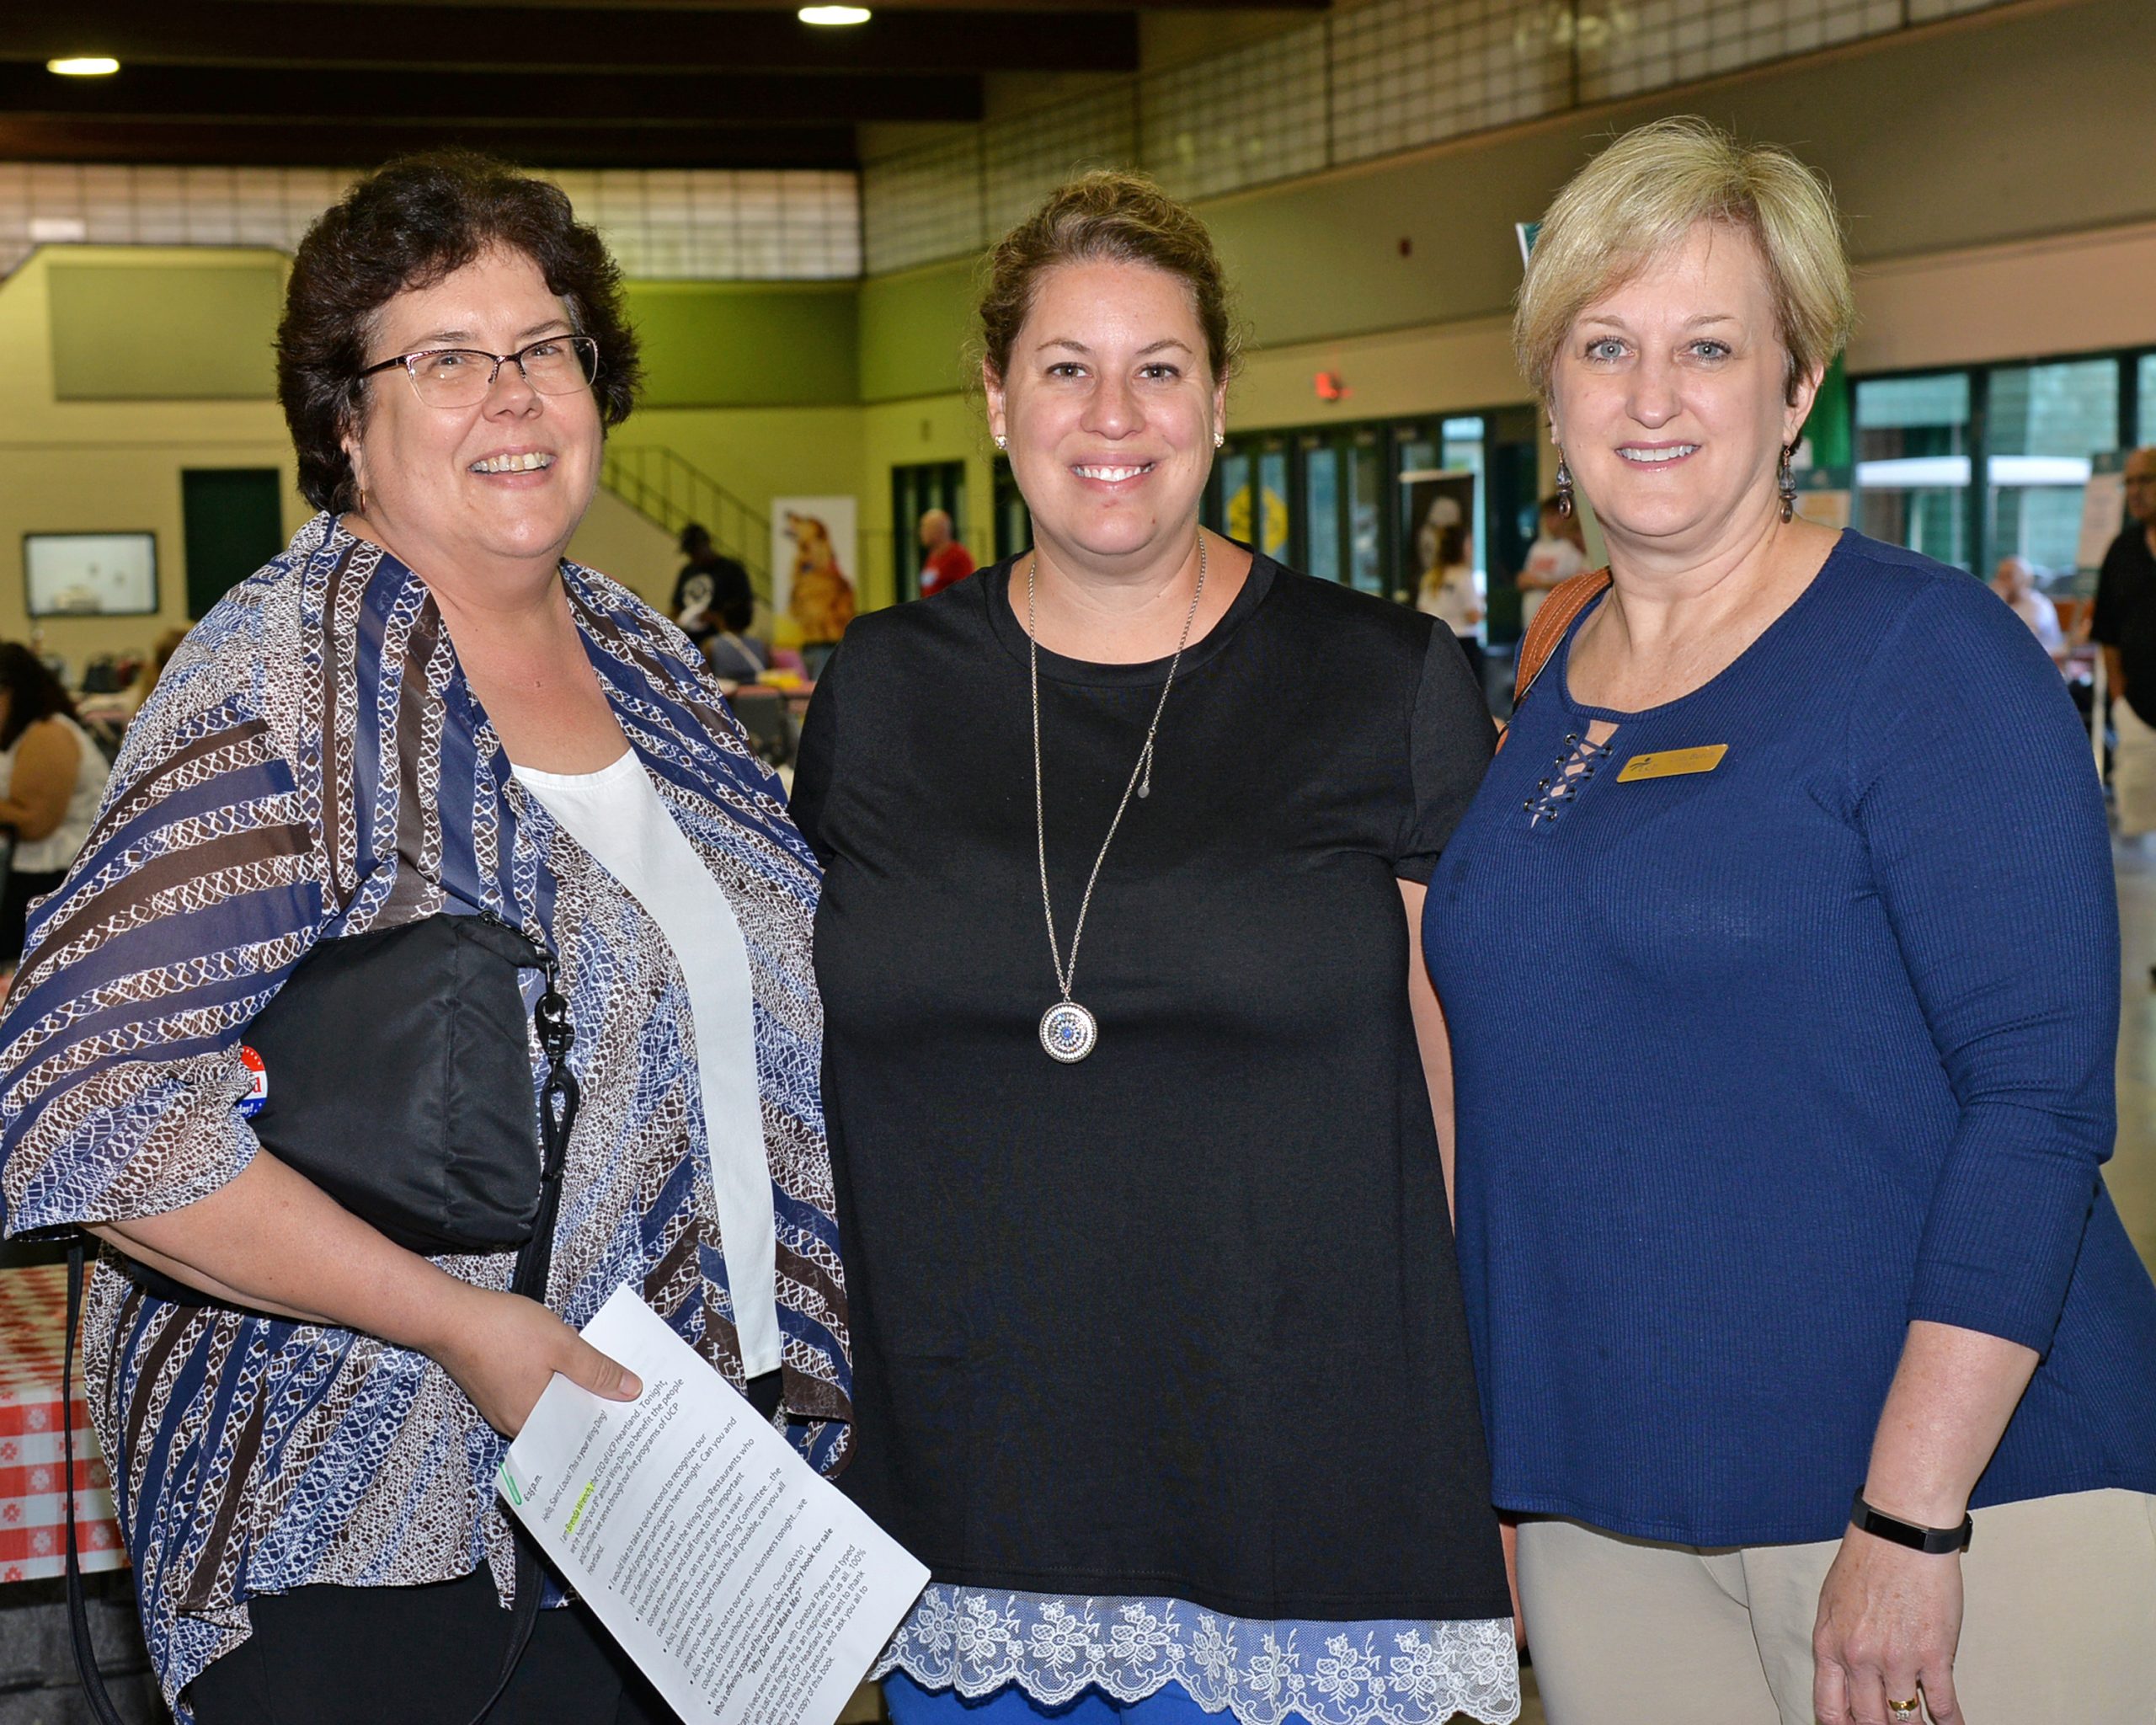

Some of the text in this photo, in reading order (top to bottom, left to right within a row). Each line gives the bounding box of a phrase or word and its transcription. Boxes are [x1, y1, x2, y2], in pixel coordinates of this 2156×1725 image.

[579, 1440, 589, 1459] your
[585, 1426, 600, 1443] Wing
[594, 1409, 608, 1429] Ding!
[598, 1476, 612, 1499] annual
[607, 1462, 622, 1479] Wing
[616, 1448, 632, 1465] Ding
[627, 1440, 635, 1450] to
[631, 1416, 654, 1442] benefit
[651, 1403, 664, 1417] the
[662, 1379, 684, 1407] people
[590, 1476, 599, 1487] the
[595, 1461, 606, 1477] CEO
[606, 1441, 616, 1457] UCP
[600, 1402, 678, 1523] serve through our five programs of UCP
[648, 1503, 674, 1543] participants
[669, 1487, 685, 1504] here
[700, 1446, 714, 1462] Can
[712, 1432, 725, 1449] you
[723, 1417, 737, 1434] and
[630, 1434, 707, 1546] take quick second to recognize our
[667, 1541, 682, 1561] thank
[678, 1530, 689, 1542] the
[685, 1512, 702, 1530] Wing
[696, 1495, 713, 1514] Ding
[707, 1455, 742, 1497] Restaurants
[739, 1439, 755, 1455] who
[652, 1520, 676, 1563] give wave?
[675, 1557, 686, 1573] and
[683, 1541, 696, 1561] staff
[692, 1528, 706, 1545] time
[702, 1519, 711, 1529] to
[707, 1506, 720, 1521] this
[716, 1472, 744, 1508] important
[696, 1551, 707, 1567] you
[710, 1528, 722, 1546] give
[719, 1519, 728, 1529] us
[728, 1492, 744, 1514] wave!
[821, 1528, 833, 1543] sale
[696, 1587, 715, 1613] helped
[712, 1570, 727, 1590] make
[723, 1557, 734, 1572] this
[732, 1546, 740, 1558] all
[758, 1506, 769, 1519] can
[766, 1492, 779, 1509] you
[777, 1481, 786, 1493] all
[696, 1570, 711, 1590] thank
[708, 1557, 718, 1571] our
[713, 1540, 732, 1559] Wing
[726, 1524, 743, 1541] Ding
[799, 1553, 815, 1572] book
[812, 1541, 822, 1554] for
[849, 1549, 867, 1569] 100%
[720, 1615, 730, 1628] out
[732, 1594, 742, 1609] our
[740, 1575, 755, 1596] event
[752, 1540, 778, 1576] volunteers
[772, 1592, 789, 1615] John's
[787, 1570, 804, 1595] poetry
[827, 1592, 836, 1600] to
[834, 1582, 843, 1592] us
[720, 1640, 731, 1654] this
[728, 1614, 746, 1641] without
[743, 1598, 755, 1617] you!
[739, 1631, 751, 1651] guest
[746, 1617, 760, 1632] here
[756, 1594, 774, 1618] tonight
[772, 1572, 787, 1591] Oscar
[760, 1613, 776, 1635] cousin
[770, 1644, 789, 1674] decades
[787, 1629, 798, 1645] with
[795, 1599, 817, 1630] Cerebral
[814, 1580, 831, 1601] Palsy
[829, 1564, 841, 1581] and
[838, 1544, 856, 1566] typed
[776, 1608, 792, 1629] Make
[788, 1664, 801, 1682] UCP
[820, 1617, 833, 1630] We
[830, 1599, 846, 1617] want
[842, 1591, 851, 1600] to
[847, 1570, 865, 1592] thank
[803, 1599, 831, 1637] inspiration
[750, 1641, 757, 1652] of
[753, 1633, 763, 1645] his
[798, 1670, 812, 1688] kind
[809, 1646, 828, 1674] gesture
[825, 1630, 837, 1646] and
[835, 1617, 846, 1632] ask
[844, 1603, 856, 1620] you
[853, 1593, 862, 1605] all
[859, 1585, 868, 1594] to
[799, 1635, 808, 1646] an
[739, 1651, 753, 1672] copies
[787, 1653, 798, 1664] He
[811, 1674, 823, 1689] this
